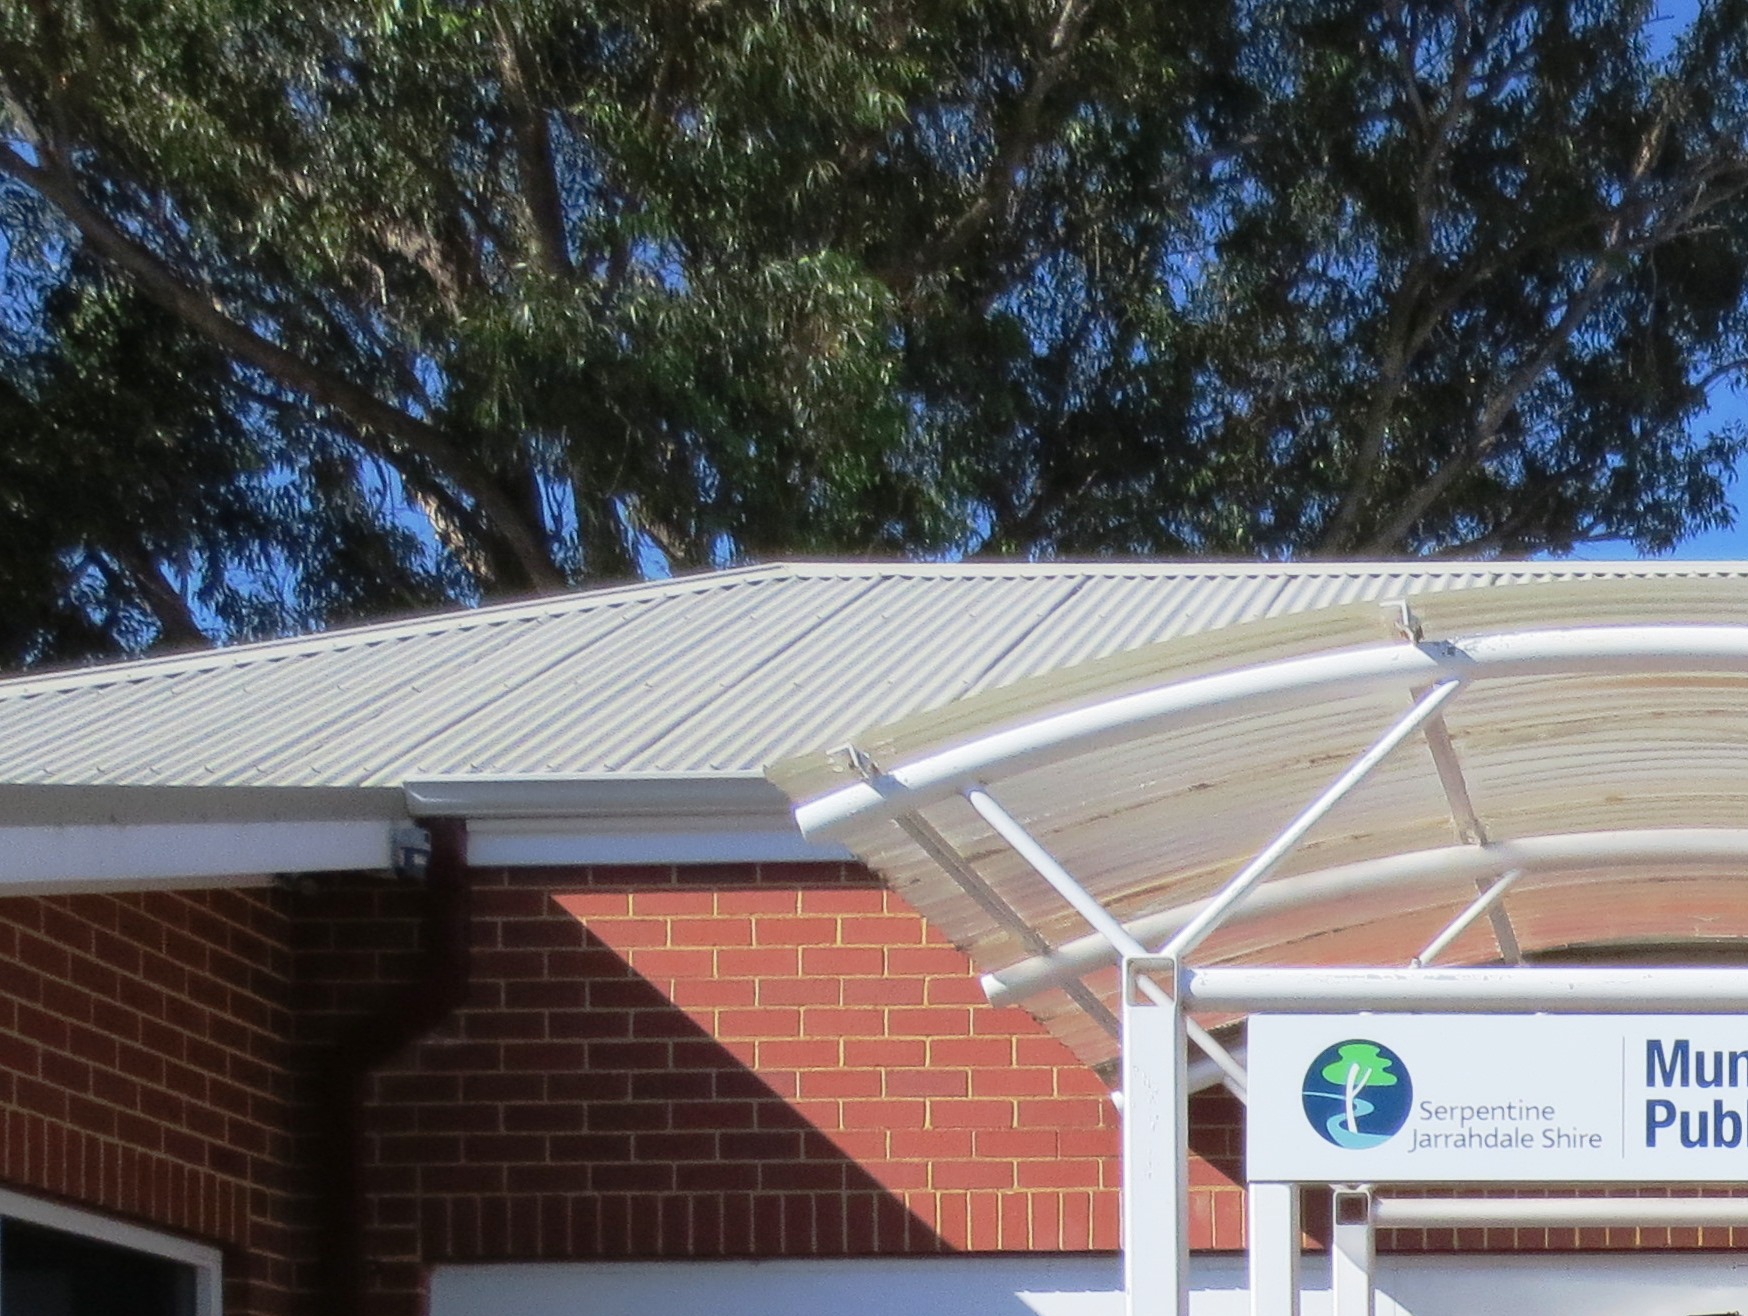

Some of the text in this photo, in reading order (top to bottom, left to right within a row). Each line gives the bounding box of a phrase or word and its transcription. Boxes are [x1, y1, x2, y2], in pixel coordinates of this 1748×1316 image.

[1419, 1099, 1556, 1128] Serpentine
[1407, 1126, 1602, 1153] Jarrahdale Shire
